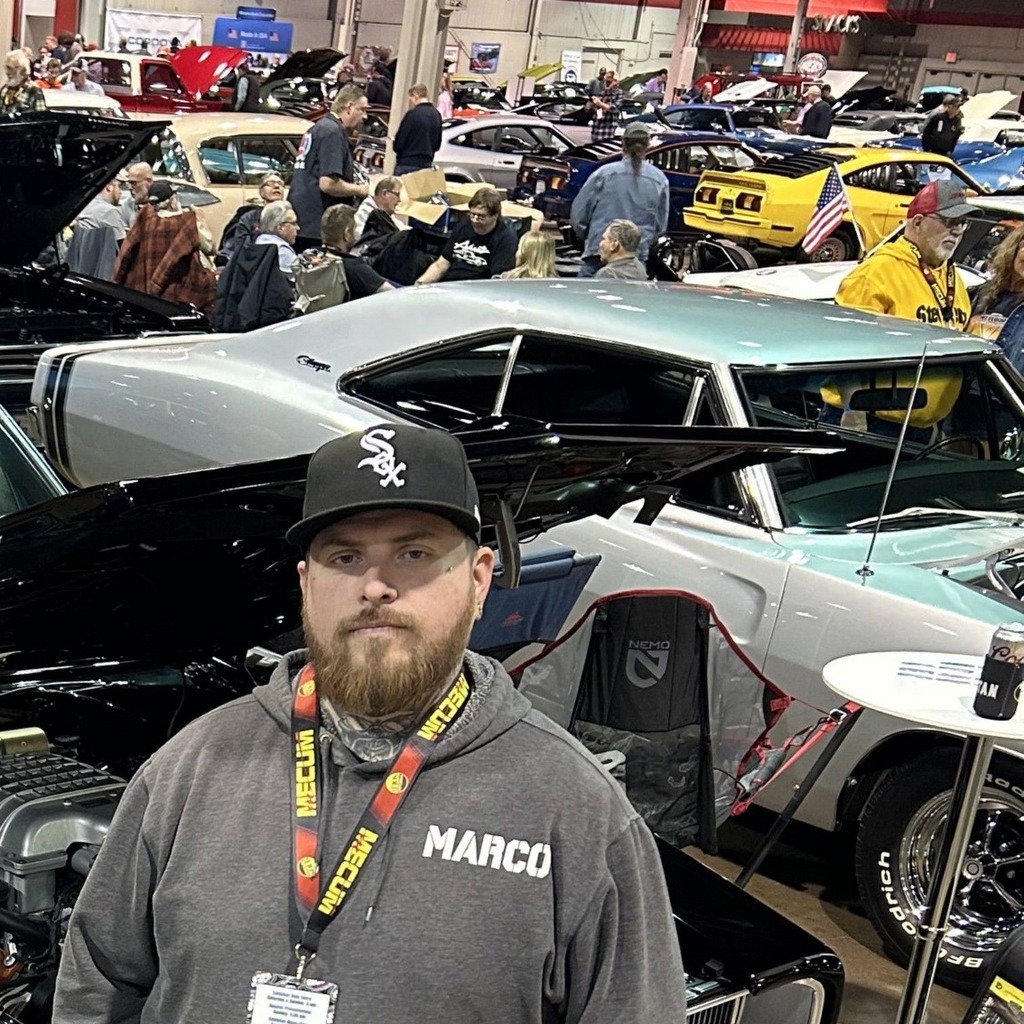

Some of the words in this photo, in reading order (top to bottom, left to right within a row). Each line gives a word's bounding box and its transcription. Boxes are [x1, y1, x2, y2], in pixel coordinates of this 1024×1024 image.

[812, 13, 862, 34] SNACKS
[357, 428, 407, 488] Sox
[628, 640, 671, 650] NEMO
[417, 672, 471, 741] MECUM
[294, 729, 318, 818] MECUM
[318, 827, 379, 916] MECUM
[422, 824, 552, 879] MARCO
